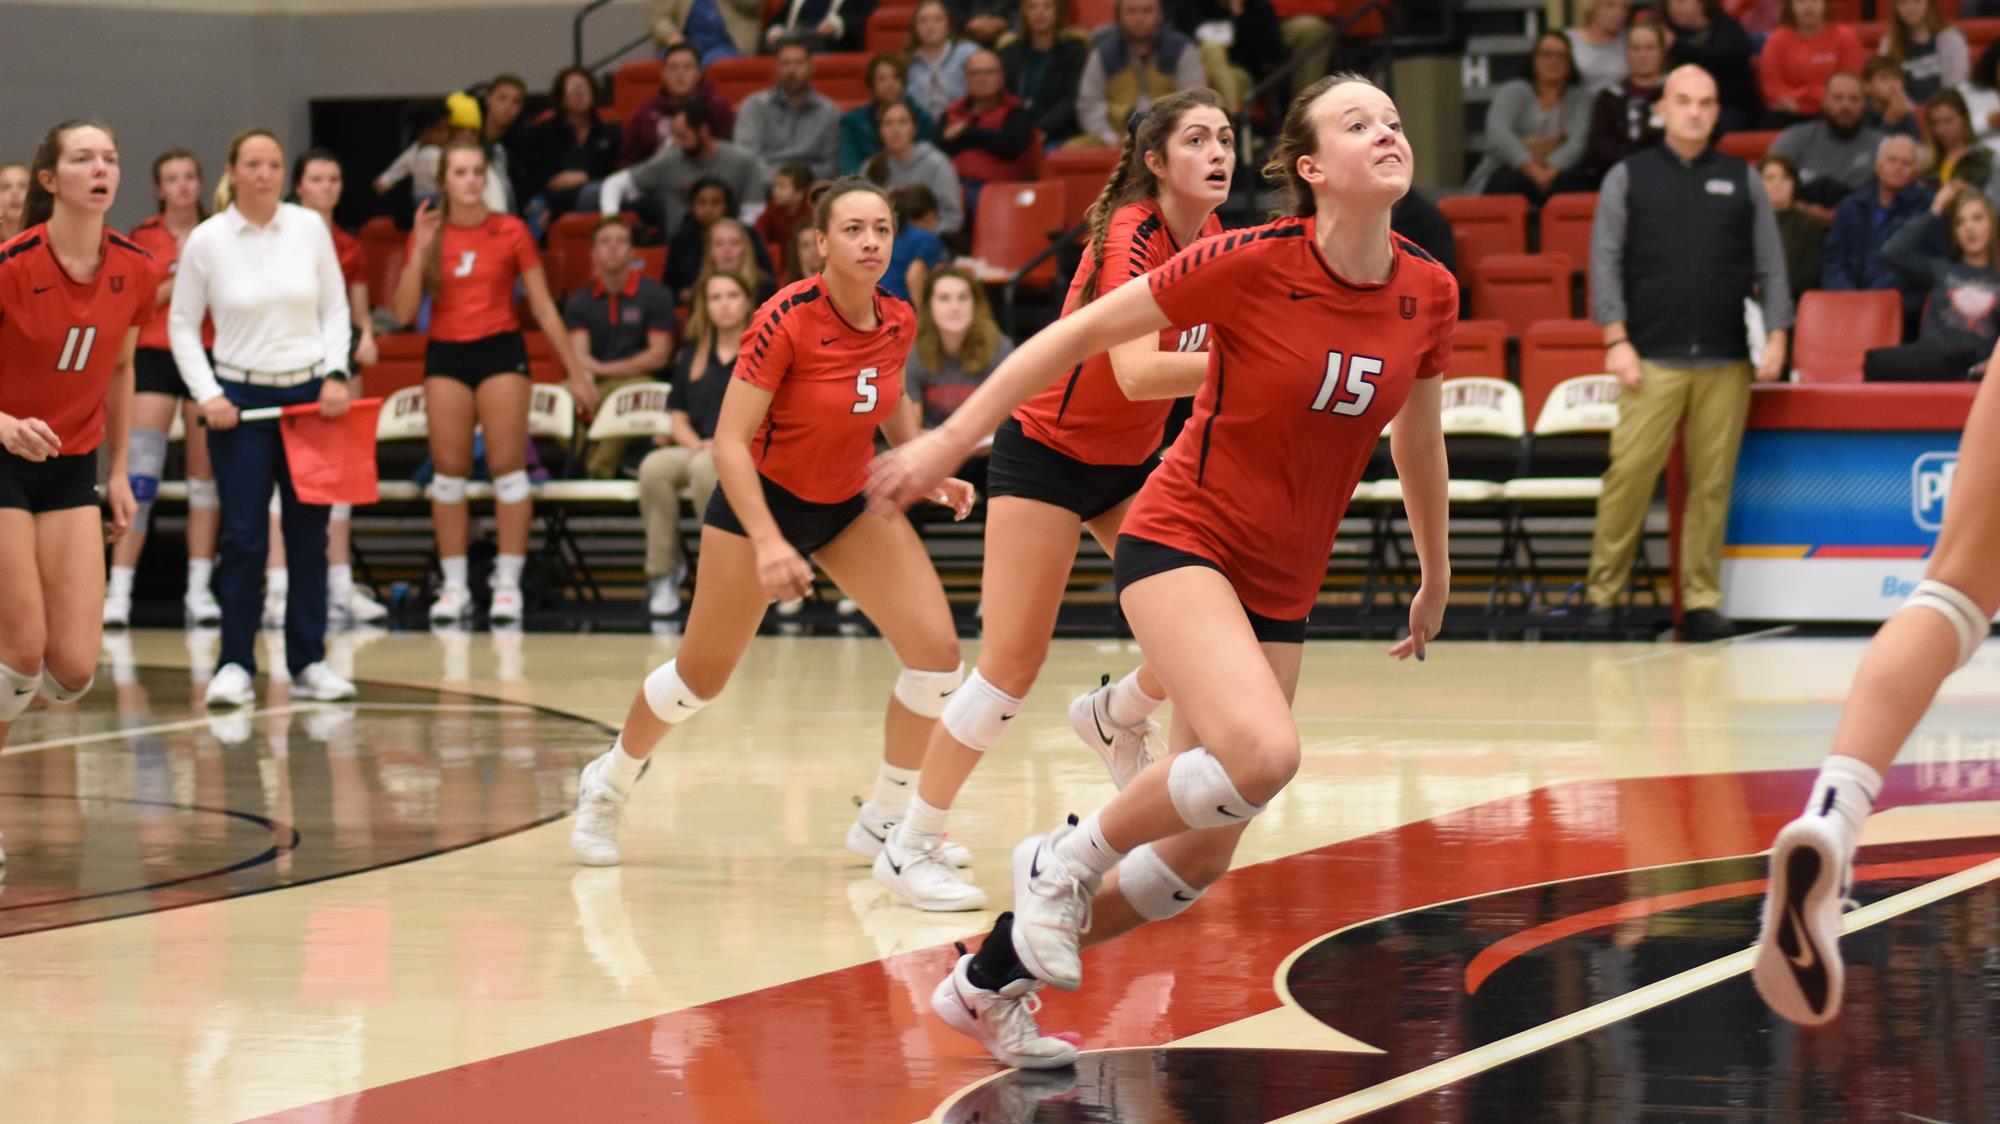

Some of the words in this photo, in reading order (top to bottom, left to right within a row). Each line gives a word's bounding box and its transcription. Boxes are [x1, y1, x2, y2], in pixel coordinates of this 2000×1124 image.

[1462, 55, 1488, 88] H
[1398, 295, 1417, 320] U
[55, 326, 97, 372] 11
[852, 366, 879, 414] 5
[1309, 350, 1384, 417] 15
[1565, 382, 1620, 411] UNIO
[615, 391, 668, 416] UNIO
